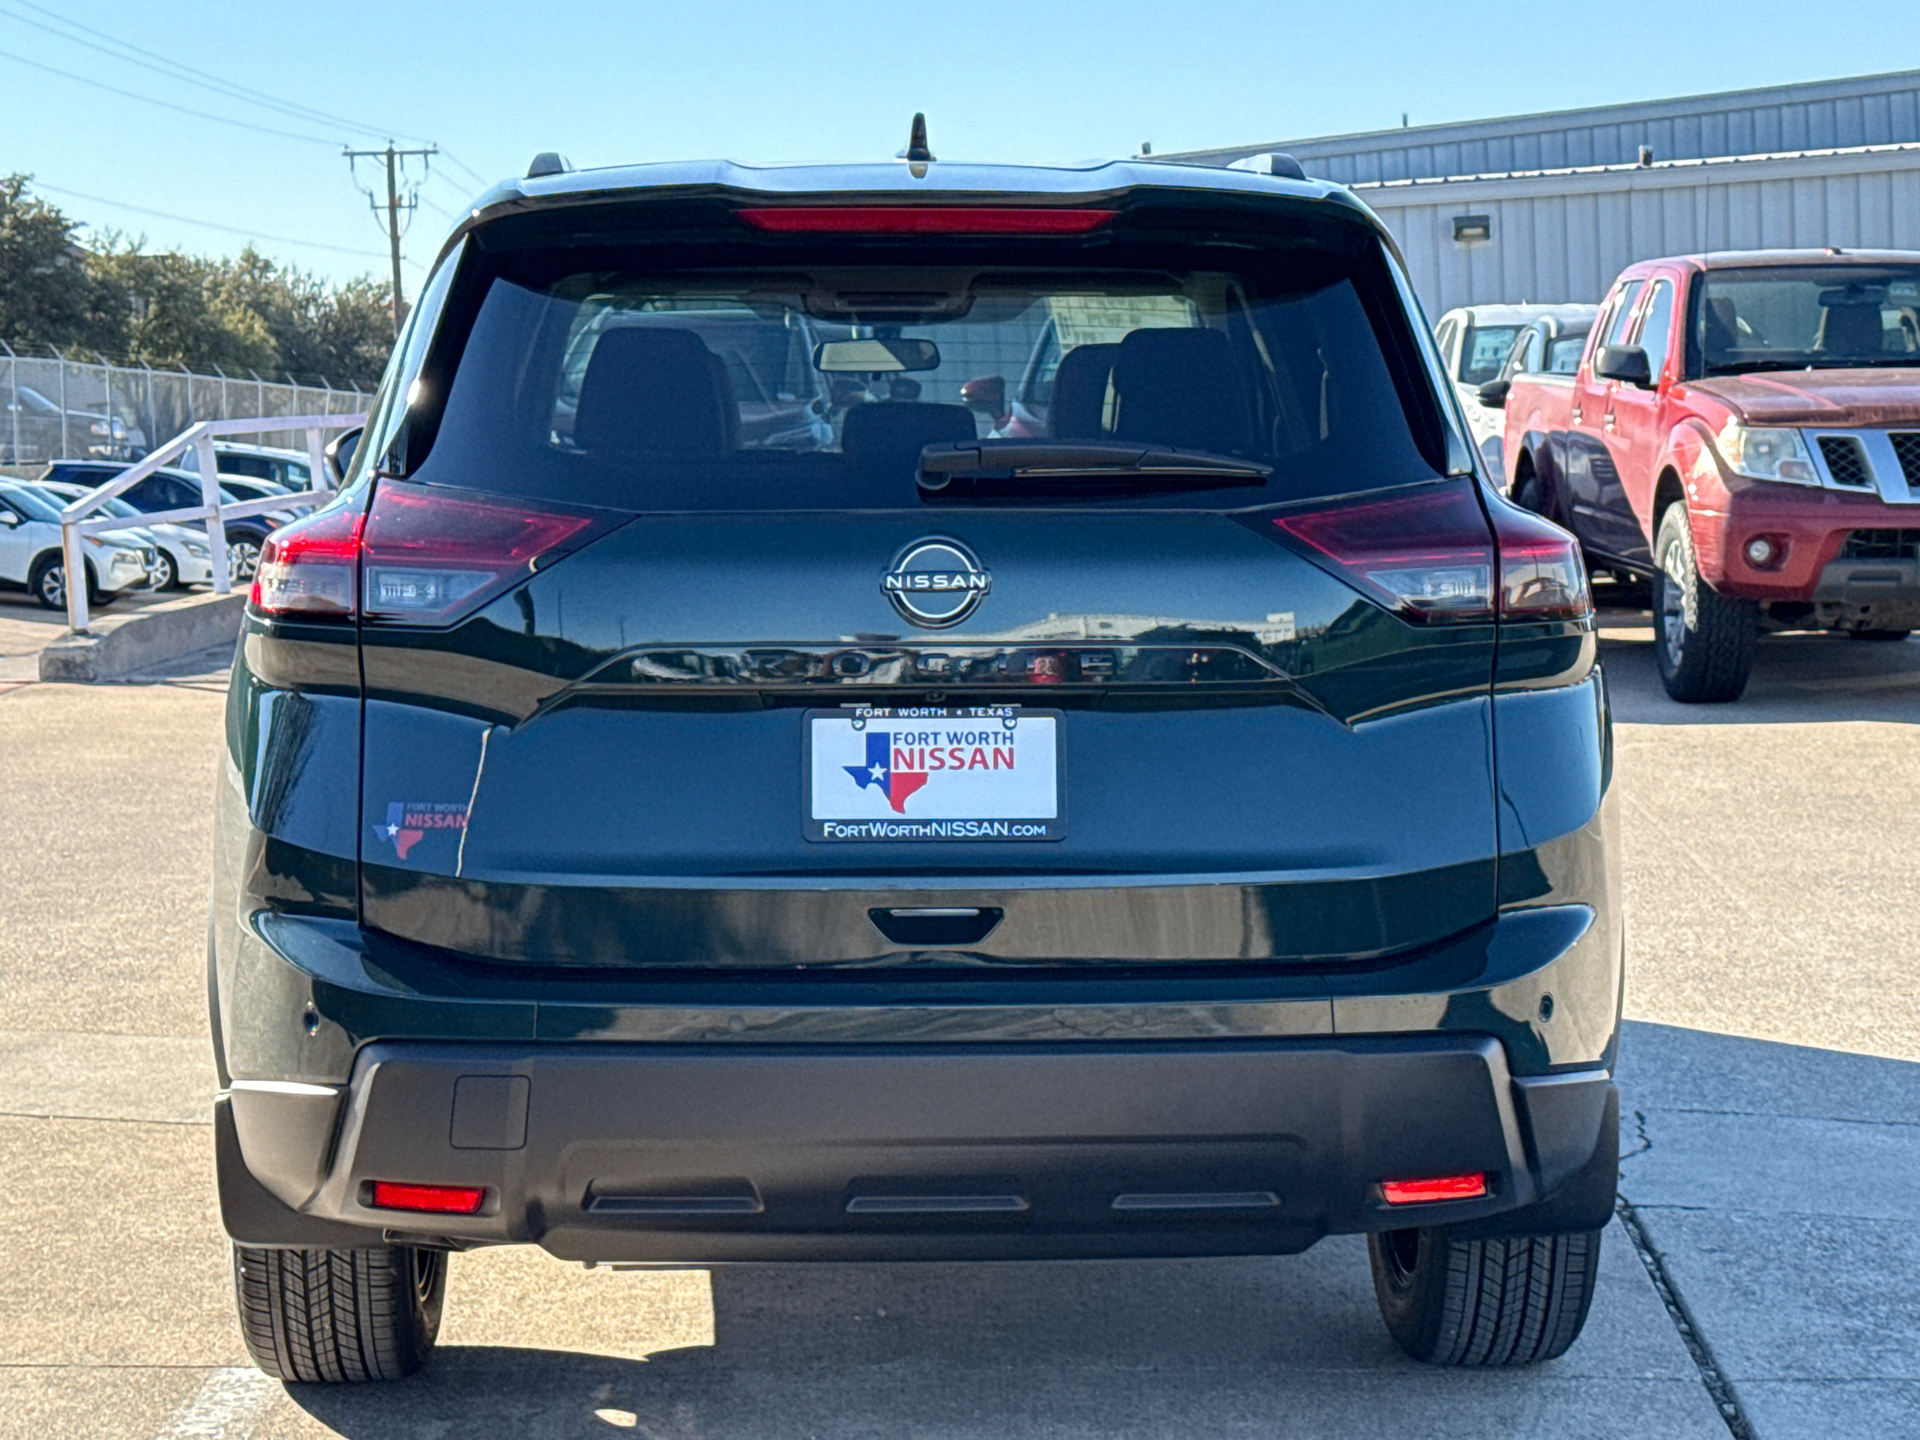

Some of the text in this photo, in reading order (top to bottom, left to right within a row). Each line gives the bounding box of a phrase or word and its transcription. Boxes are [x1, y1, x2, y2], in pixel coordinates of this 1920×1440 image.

[886, 575, 986, 588] NISSAN
[749, 653, 1114, 677] ROGUE
[856, 708, 1013, 717] FORT WORTH TEXAS
[893, 732, 1014, 745] FORT WORTH
[893, 747, 1014, 770] NISSAN
[407, 802, 432, 812] FORT
[405, 813, 468, 829] NISSAN
